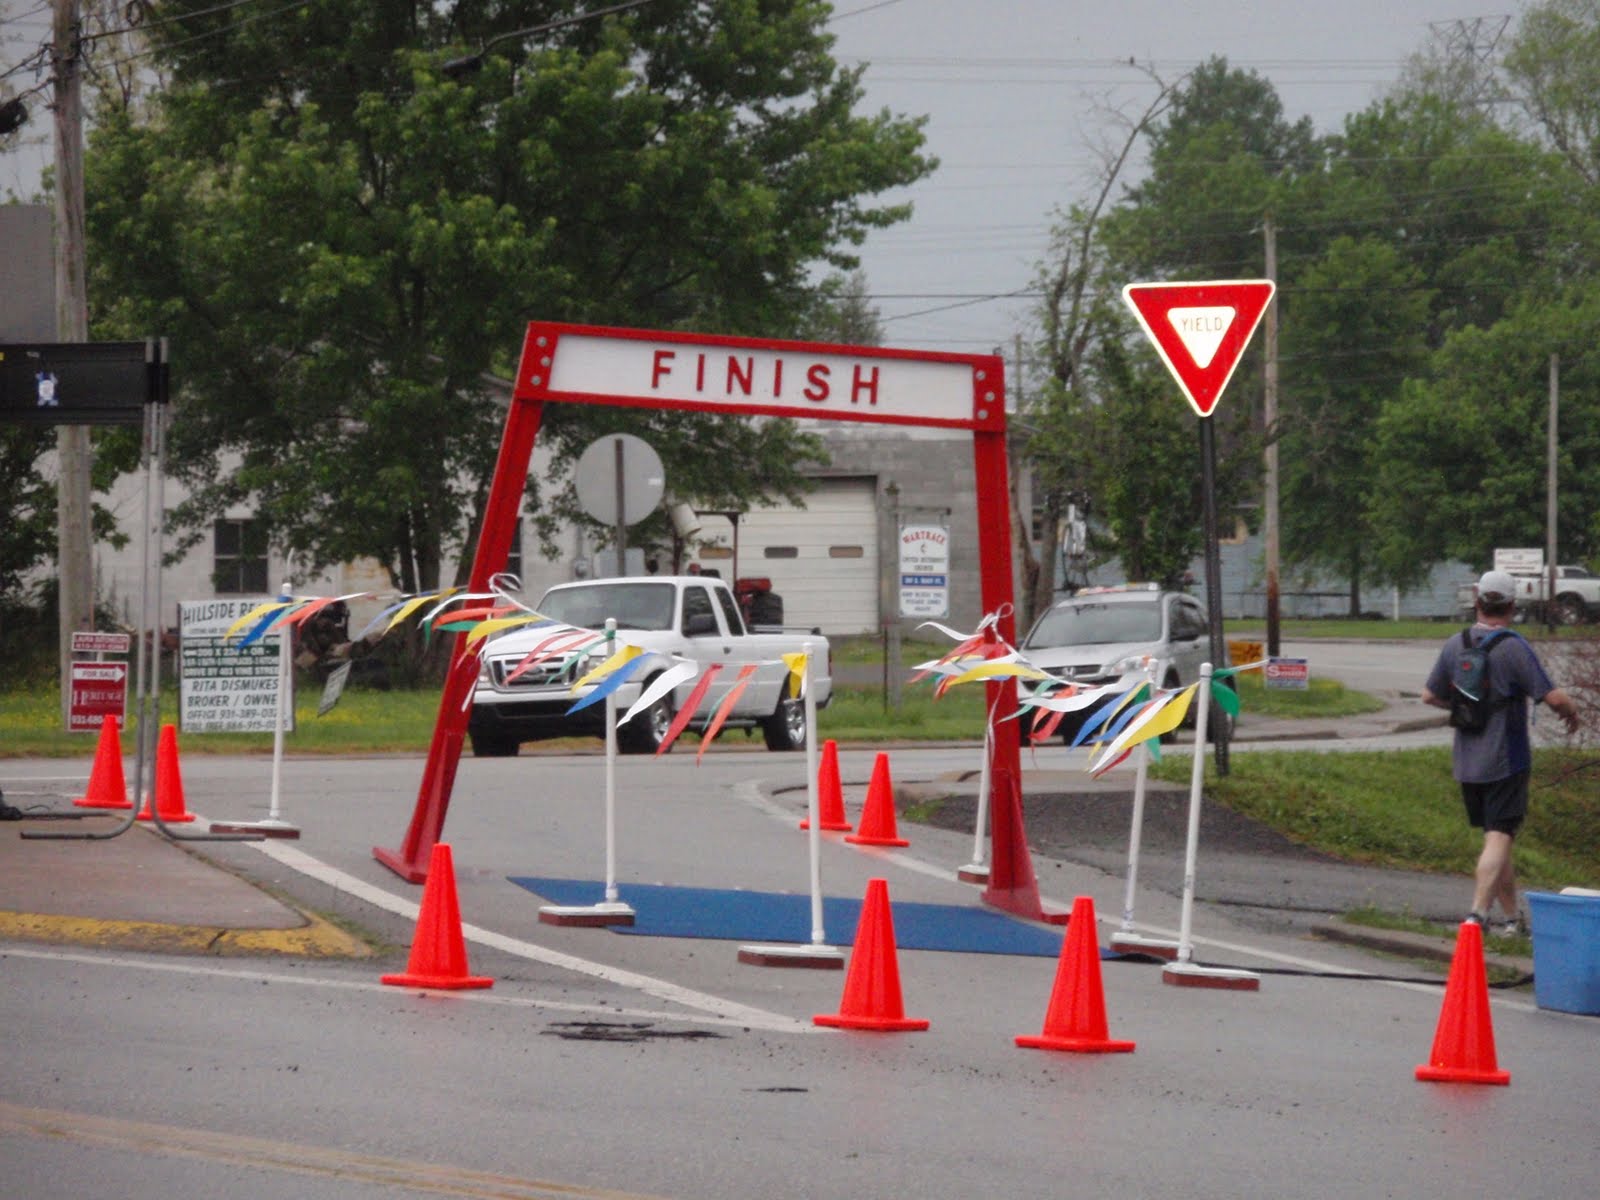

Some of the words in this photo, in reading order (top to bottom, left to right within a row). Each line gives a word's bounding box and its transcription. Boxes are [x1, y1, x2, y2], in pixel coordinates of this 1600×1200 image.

[1181, 317, 1223, 331] YIELD
[651, 350, 879, 405] FINISH
[183, 602, 235, 626] HILLSIDE
[192, 681, 217, 692] RITA
[221, 679, 279, 691] DISMUKES
[187, 696, 230, 707] BROKER
[243, 694, 277, 706] OWNE
